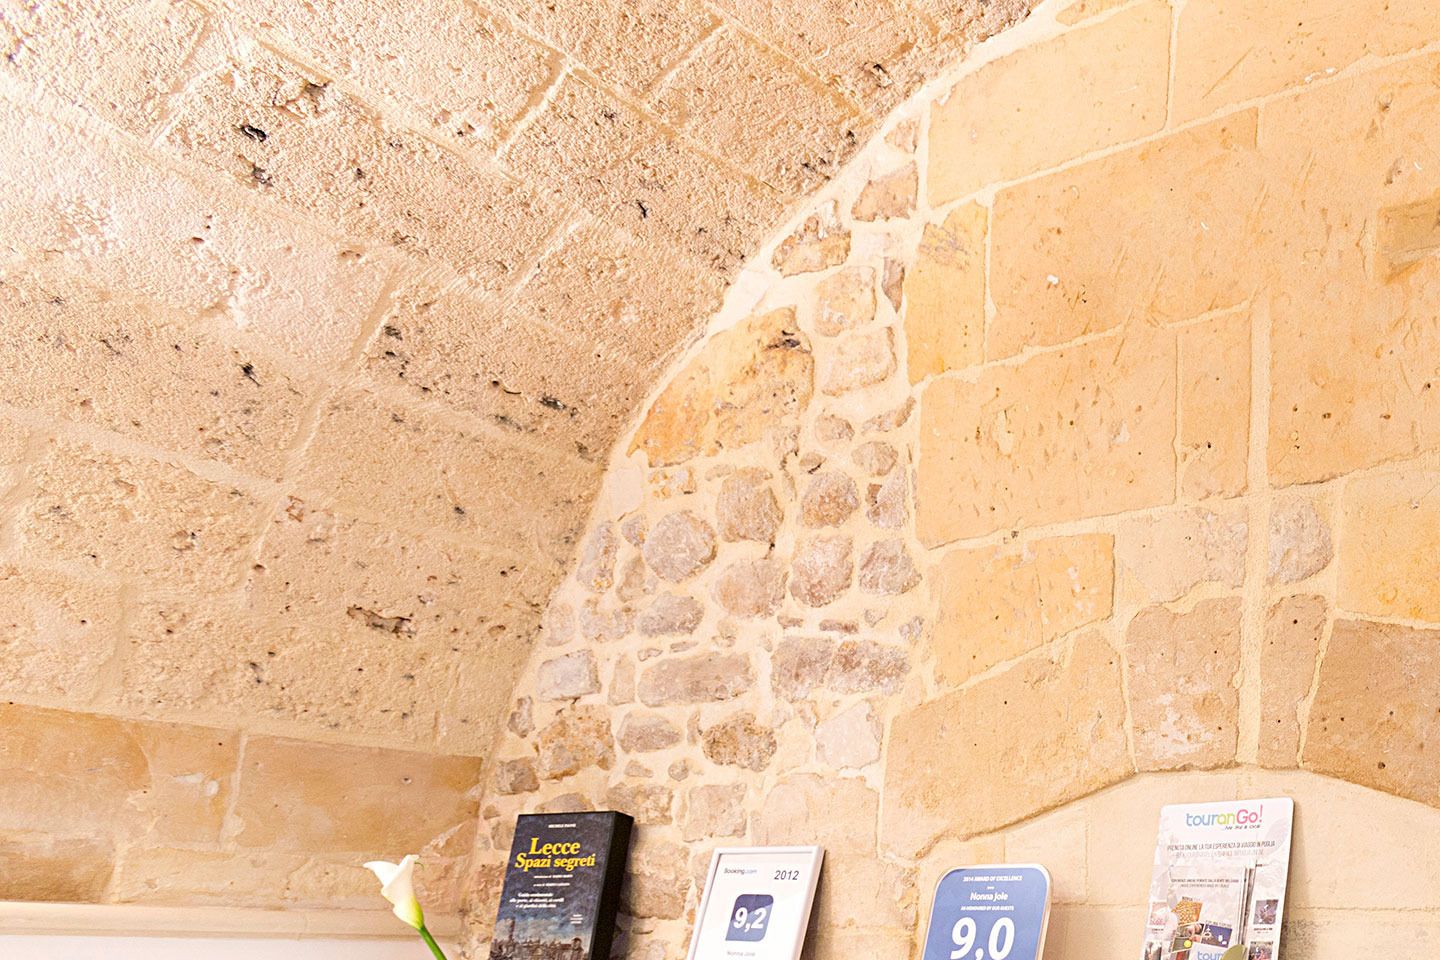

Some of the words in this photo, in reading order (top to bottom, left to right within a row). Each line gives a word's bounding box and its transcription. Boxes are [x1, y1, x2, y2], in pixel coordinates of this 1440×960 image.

[528, 838, 580, 855] Lecce
[515, 853, 552, 872] Spazi
[554, 853, 596, 871] segreti
[774, 870, 799, 880] 2012
[970, 892, 993, 900] Nonna
[733, 907, 766, 933] 9,2
